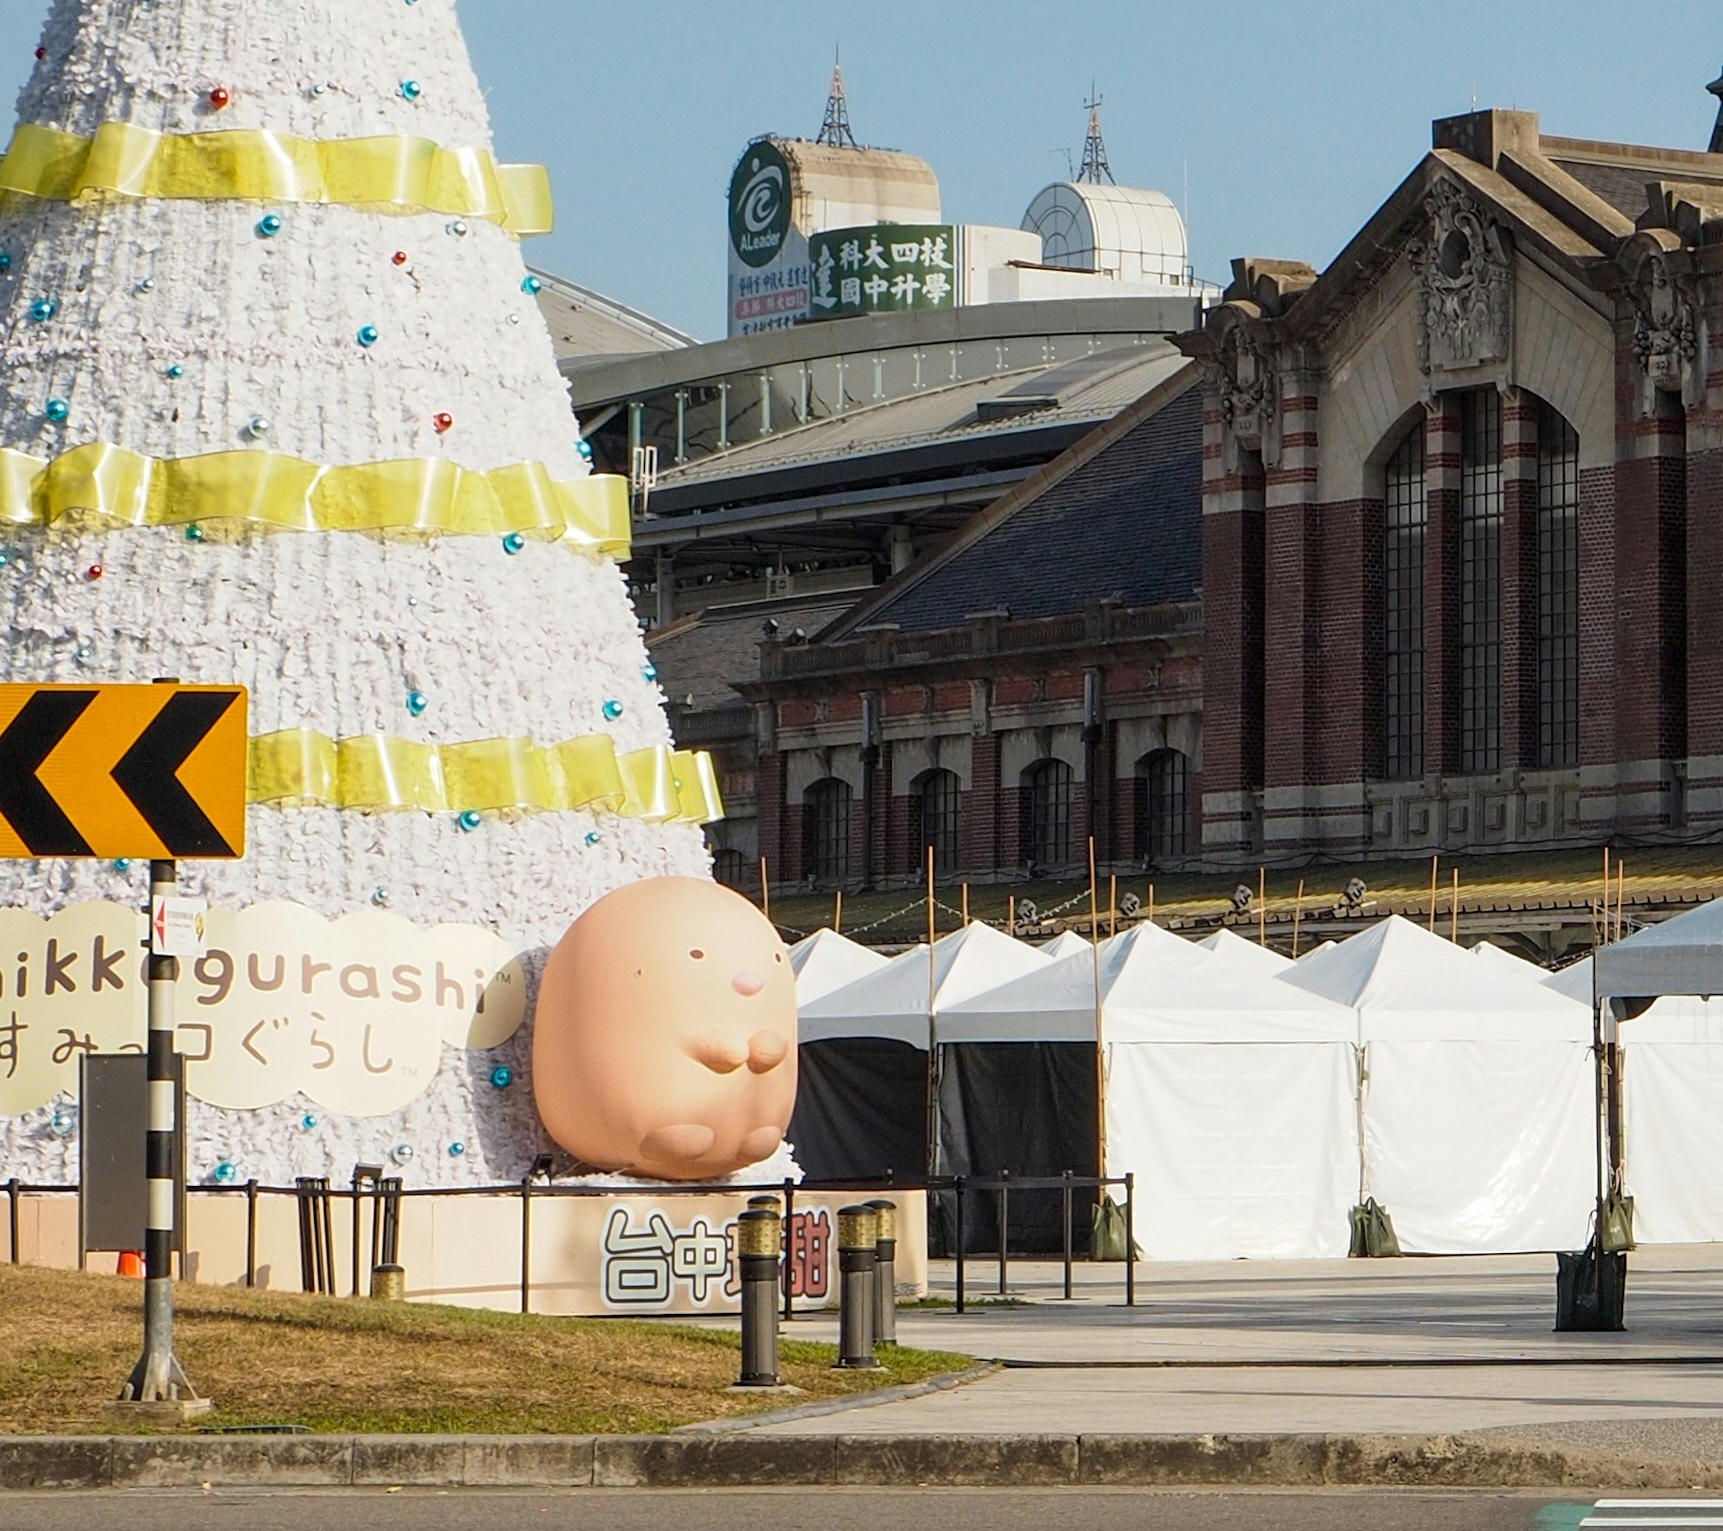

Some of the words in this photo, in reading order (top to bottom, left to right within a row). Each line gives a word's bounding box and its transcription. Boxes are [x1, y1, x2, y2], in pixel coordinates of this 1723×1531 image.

[740, 232, 780, 252] ALeader
[840, 236, 954, 269] 科大四技
[840, 273, 952, 306] 國中升學
[0, 935, 484, 1014] ikkgurashi
[605, 1209, 830, 1303] 台中甜
